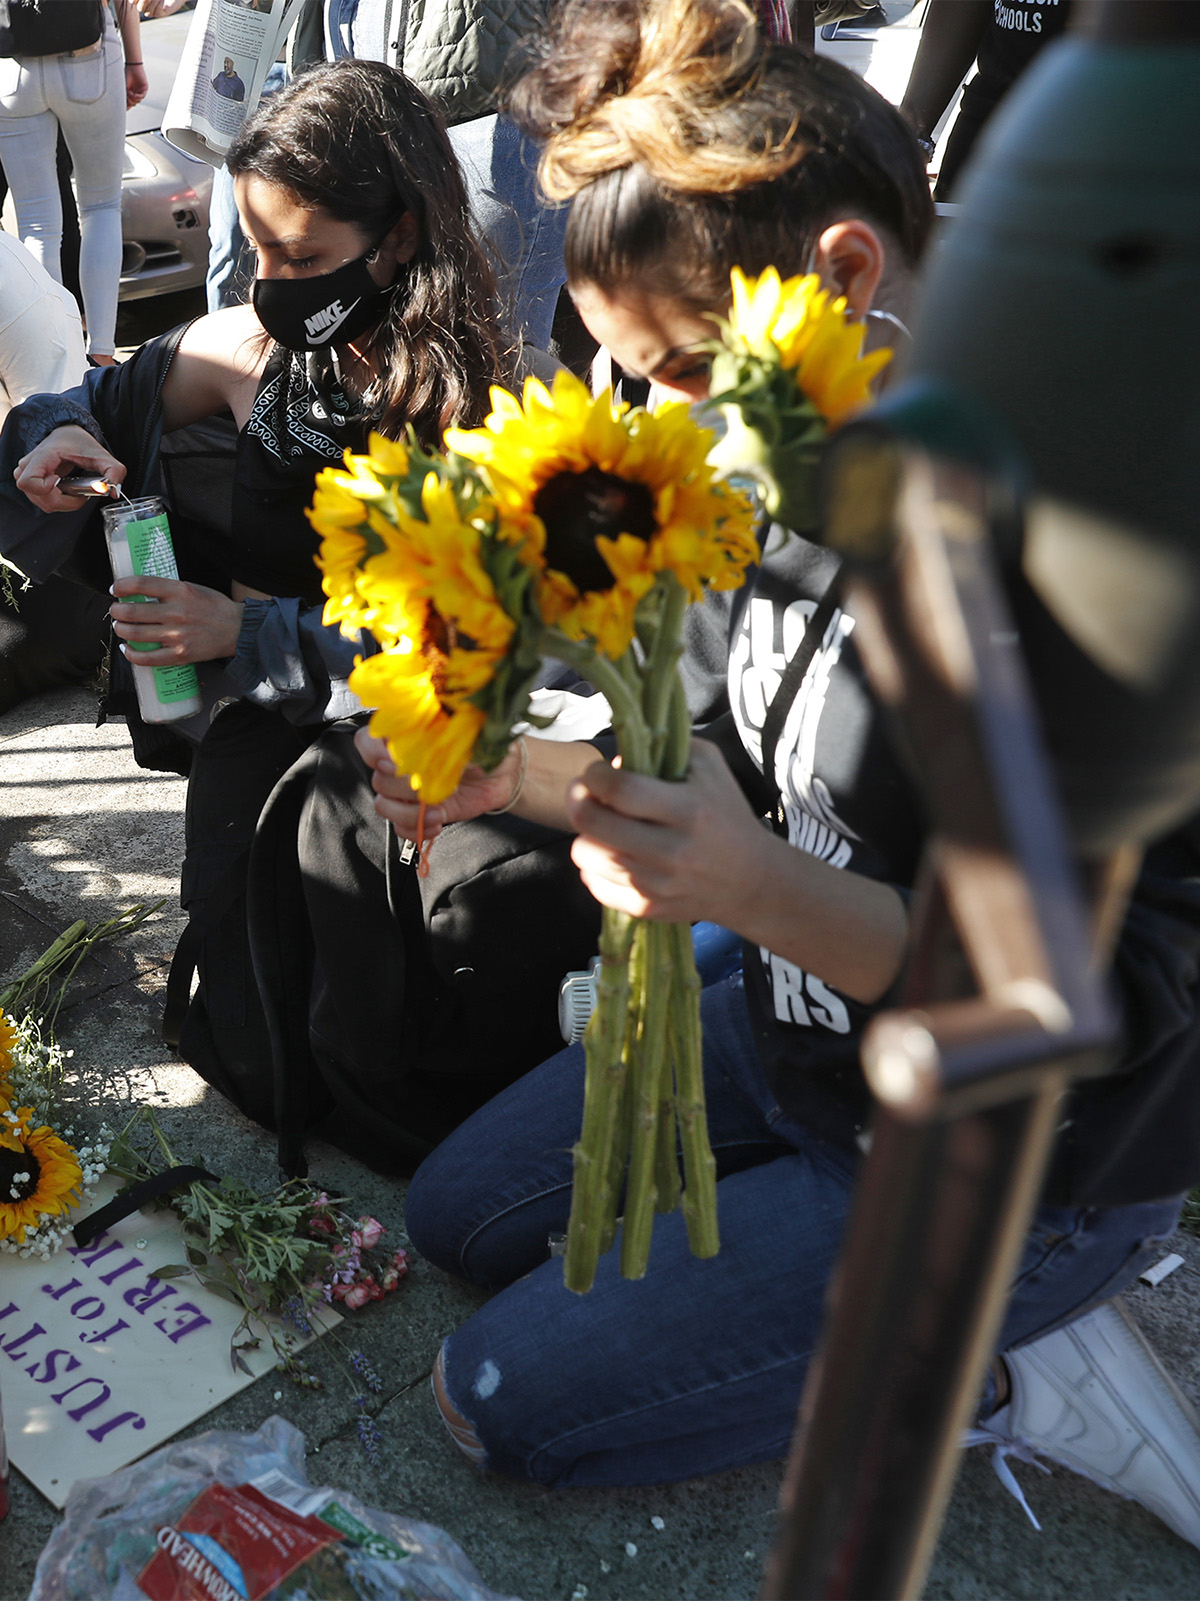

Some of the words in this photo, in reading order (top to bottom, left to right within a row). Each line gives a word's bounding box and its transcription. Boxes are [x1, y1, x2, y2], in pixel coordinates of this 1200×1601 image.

[994, 6, 1043, 33] SCHOOLS
[304, 299, 346, 336] NIKE
[66, 1230, 212, 1344] ERIK
